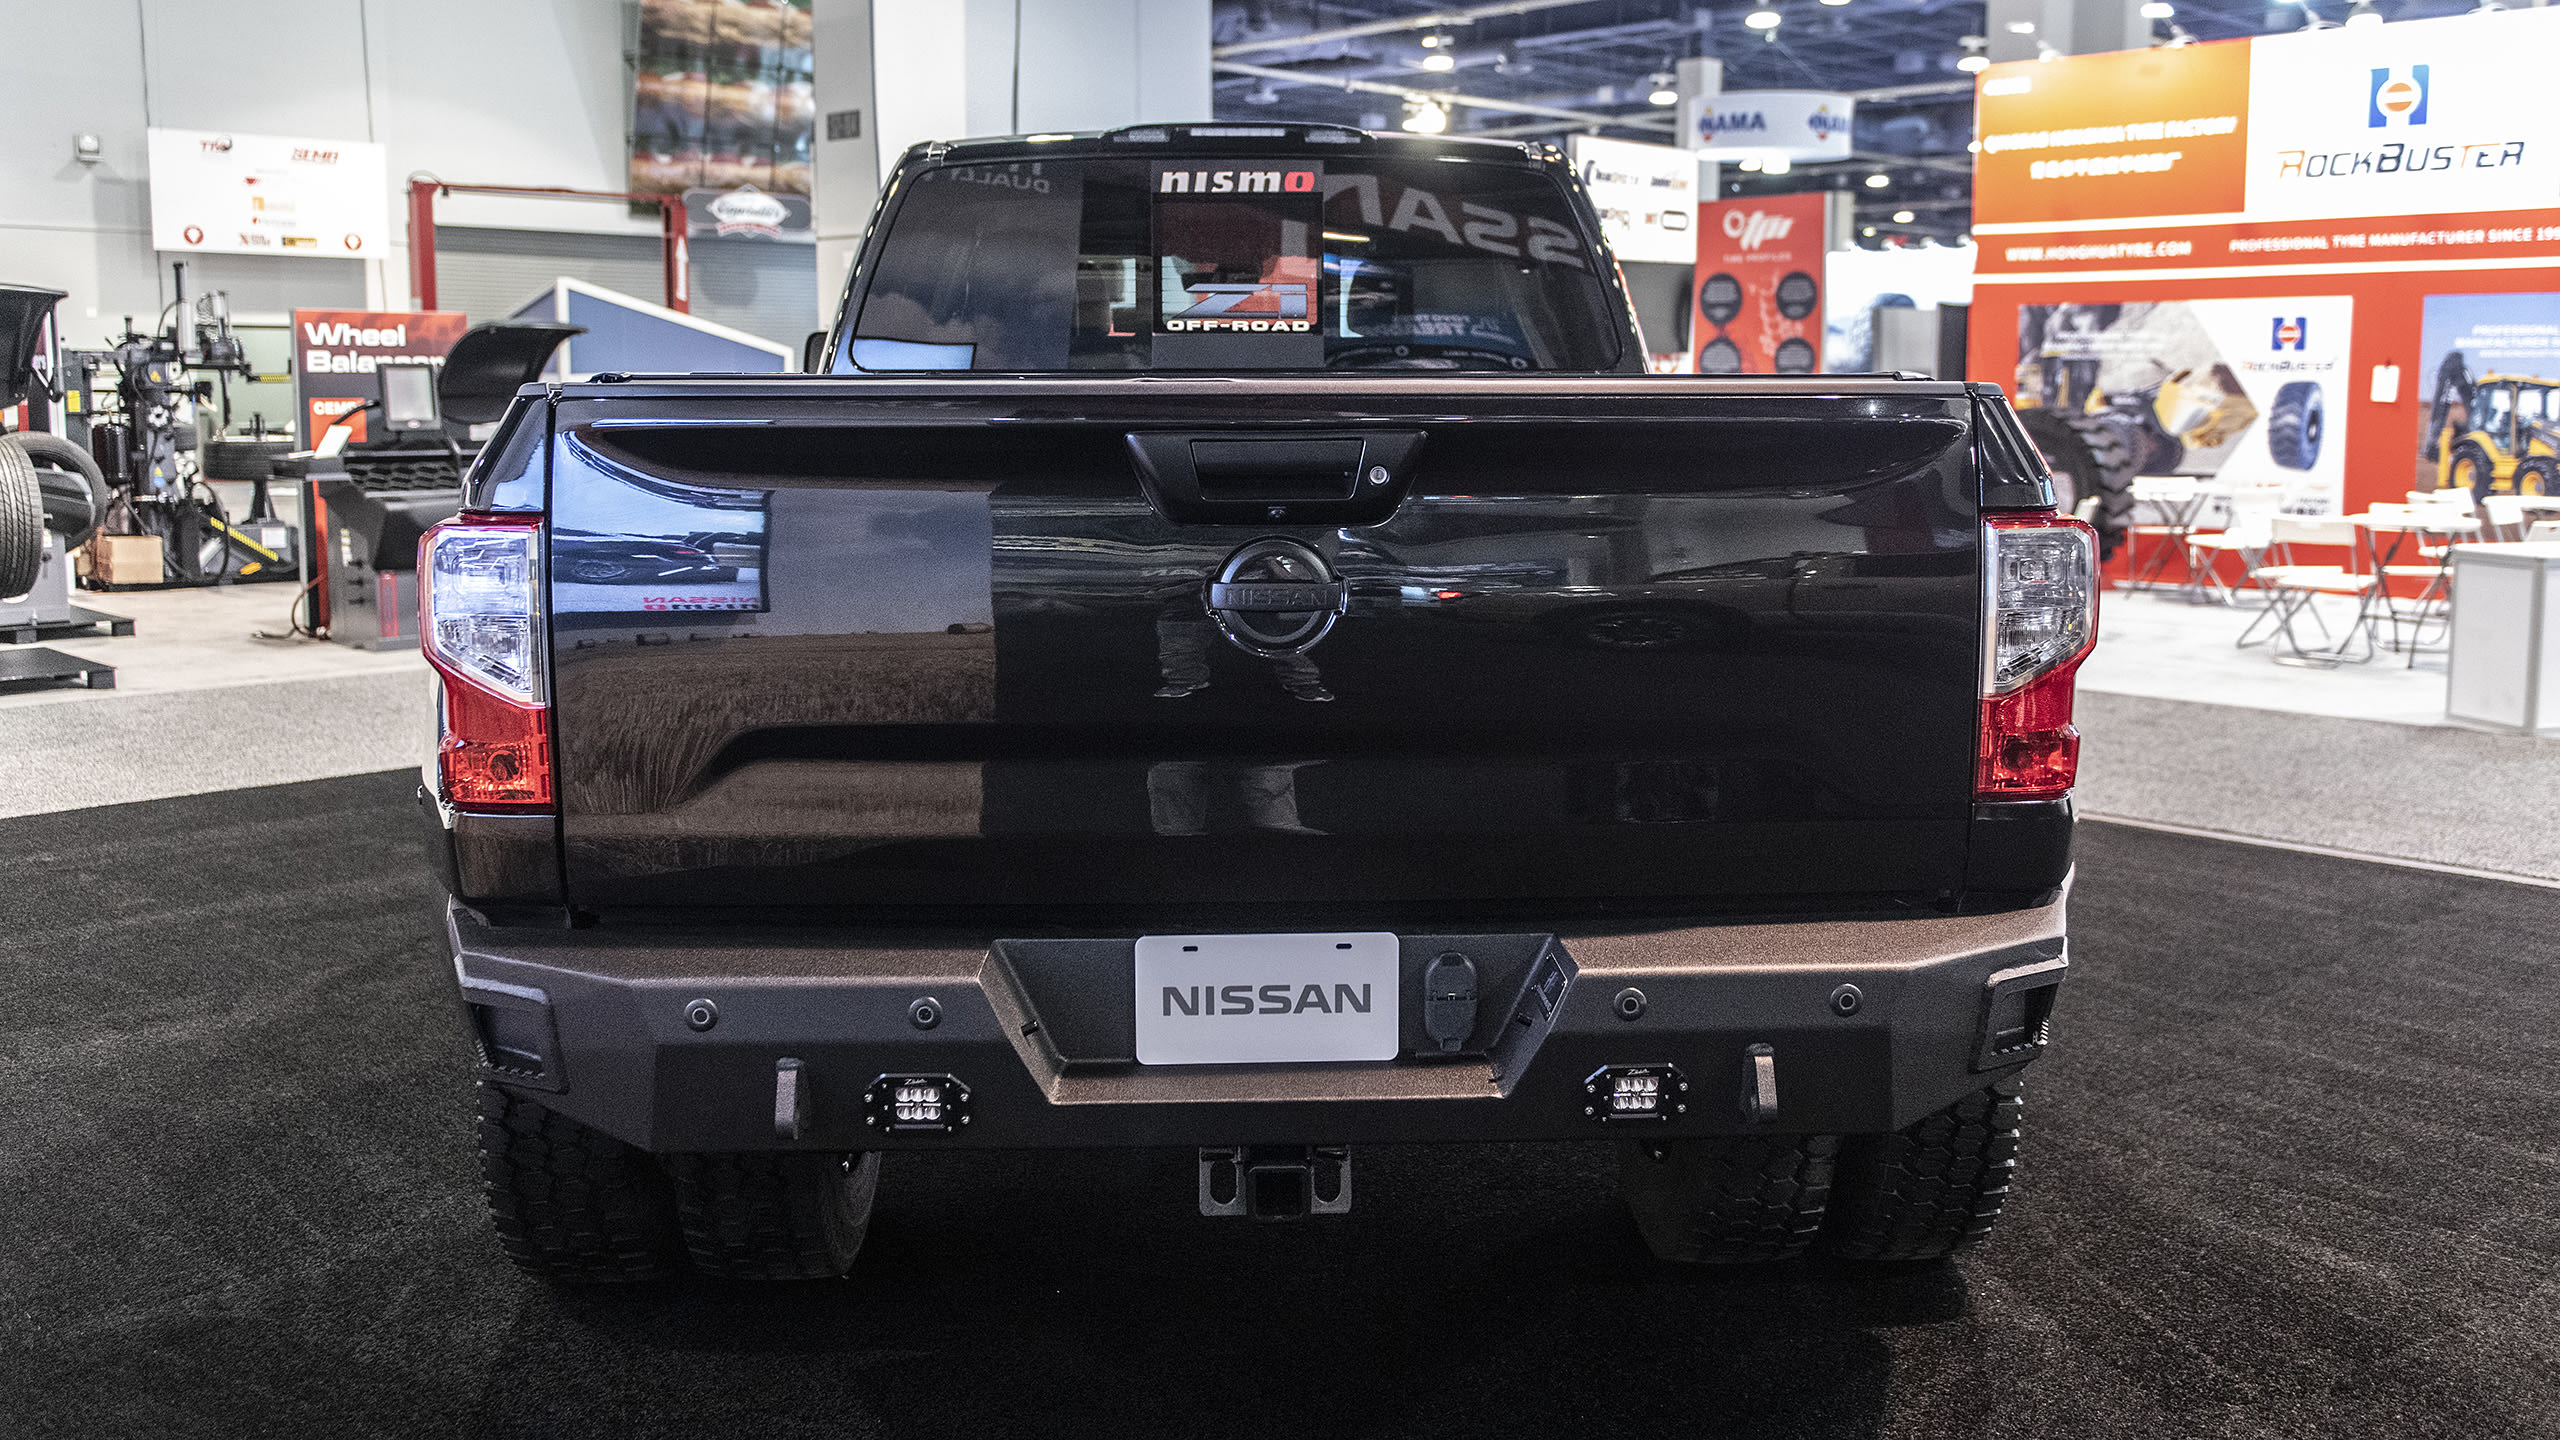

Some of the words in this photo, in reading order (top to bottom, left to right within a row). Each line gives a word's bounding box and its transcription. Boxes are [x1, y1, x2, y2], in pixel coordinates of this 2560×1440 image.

[1160, 171, 1315, 193] nismo
[2229, 236, 2329, 253] PROFESSIONAL
[2331, 233, 2366, 249] TYRE
[2367, 228, 2485, 248] MANUFACTURER
[2486, 226, 2533, 244] SINCE
[304, 322, 406, 347] Wheel
[1166, 319, 1310, 332] OFF-ROAD
[1226, 588, 1328, 606] NISSAN
[1162, 983, 1371, 1017] NISSAN
